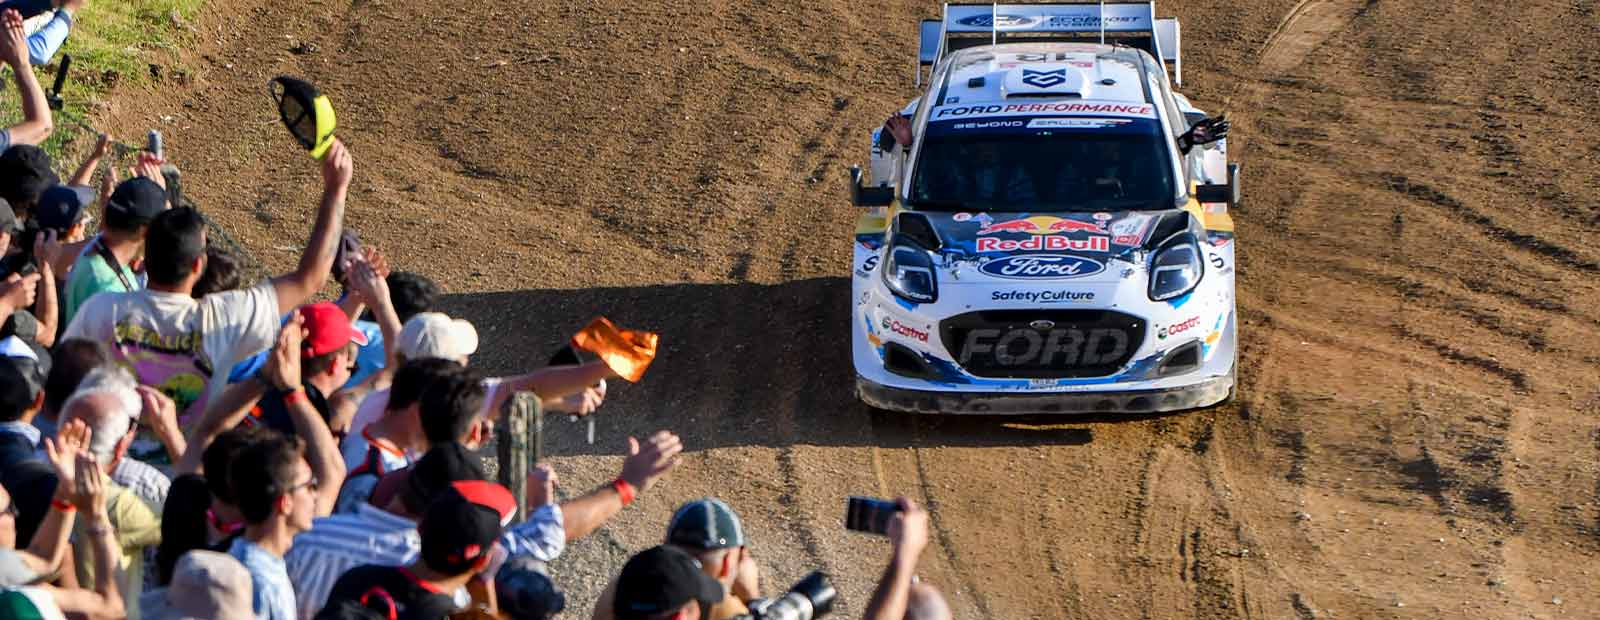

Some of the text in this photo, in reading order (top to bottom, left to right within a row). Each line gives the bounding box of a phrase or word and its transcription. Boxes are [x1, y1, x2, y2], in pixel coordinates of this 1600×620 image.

[936, 103, 1151, 118] FORD PERFORMANCE
[954, 121, 1024, 129] BEYOND
[976, 235, 1110, 252] Red Bull
[1001, 257, 1084, 275] Ford
[891, 320, 929, 342] Castrol
[959, 328, 1128, 366] FORD
